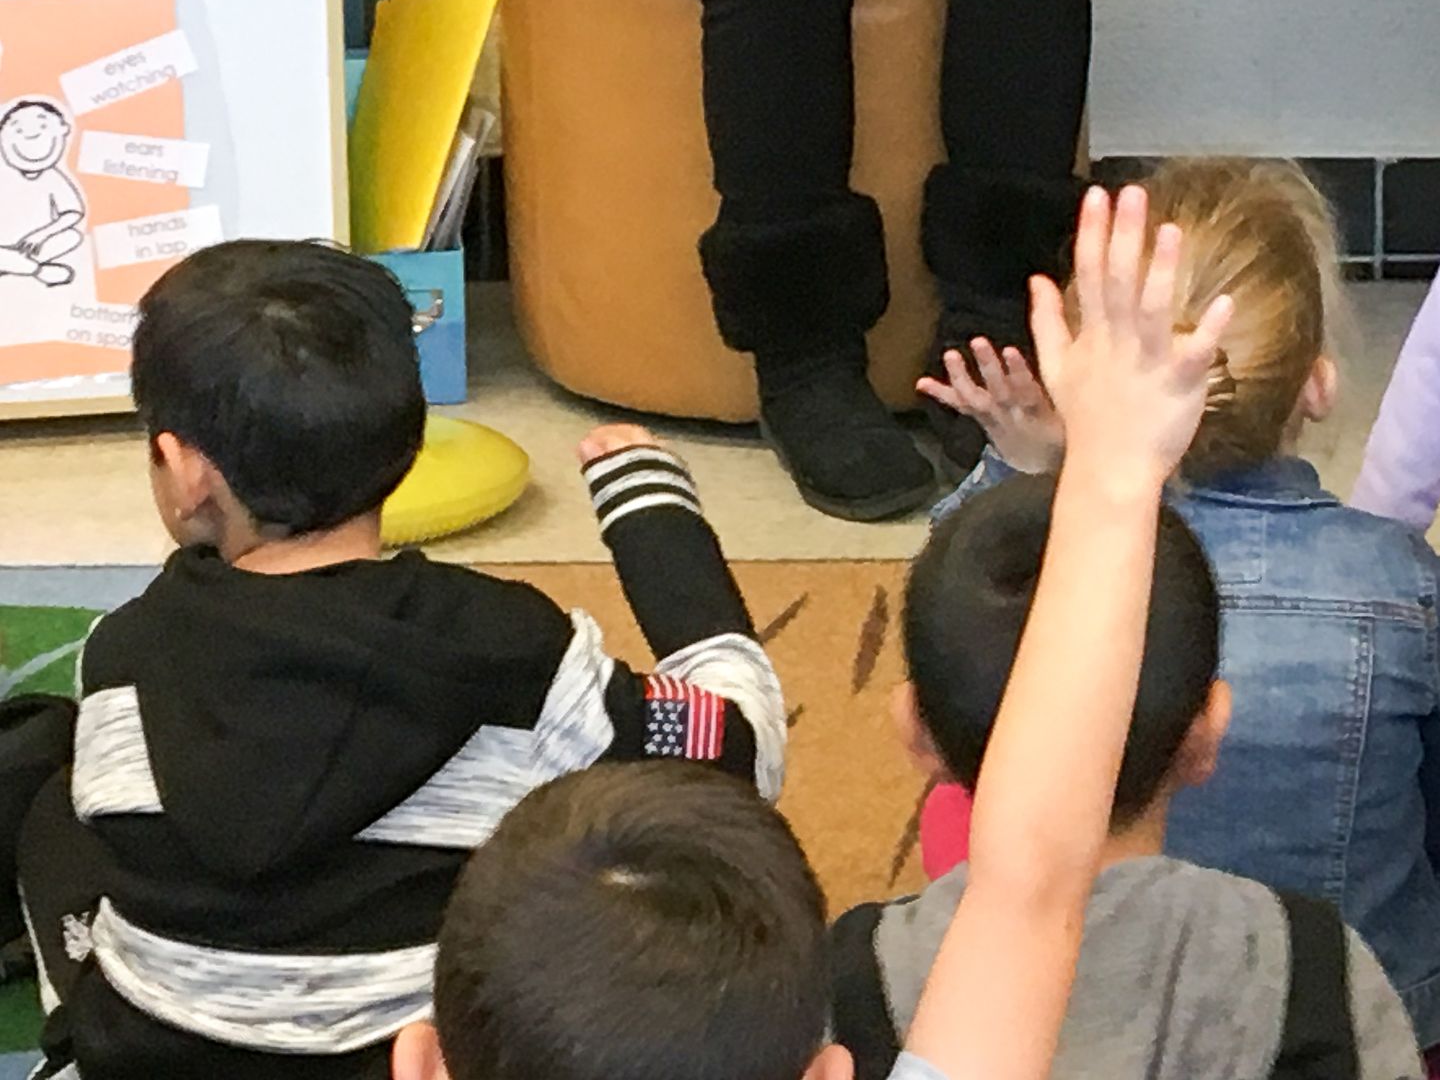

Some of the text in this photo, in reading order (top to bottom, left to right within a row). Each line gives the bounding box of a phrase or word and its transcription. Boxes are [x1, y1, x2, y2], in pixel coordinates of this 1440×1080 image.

[104, 51, 147, 76] eyes
[91, 64, 177, 105] watching
[124, 141, 164, 157] ears
[103, 158, 179, 184] listening
[128, 216, 188, 238] hands
[135, 244, 151, 260] in
[66, 328, 134, 348] on spo
